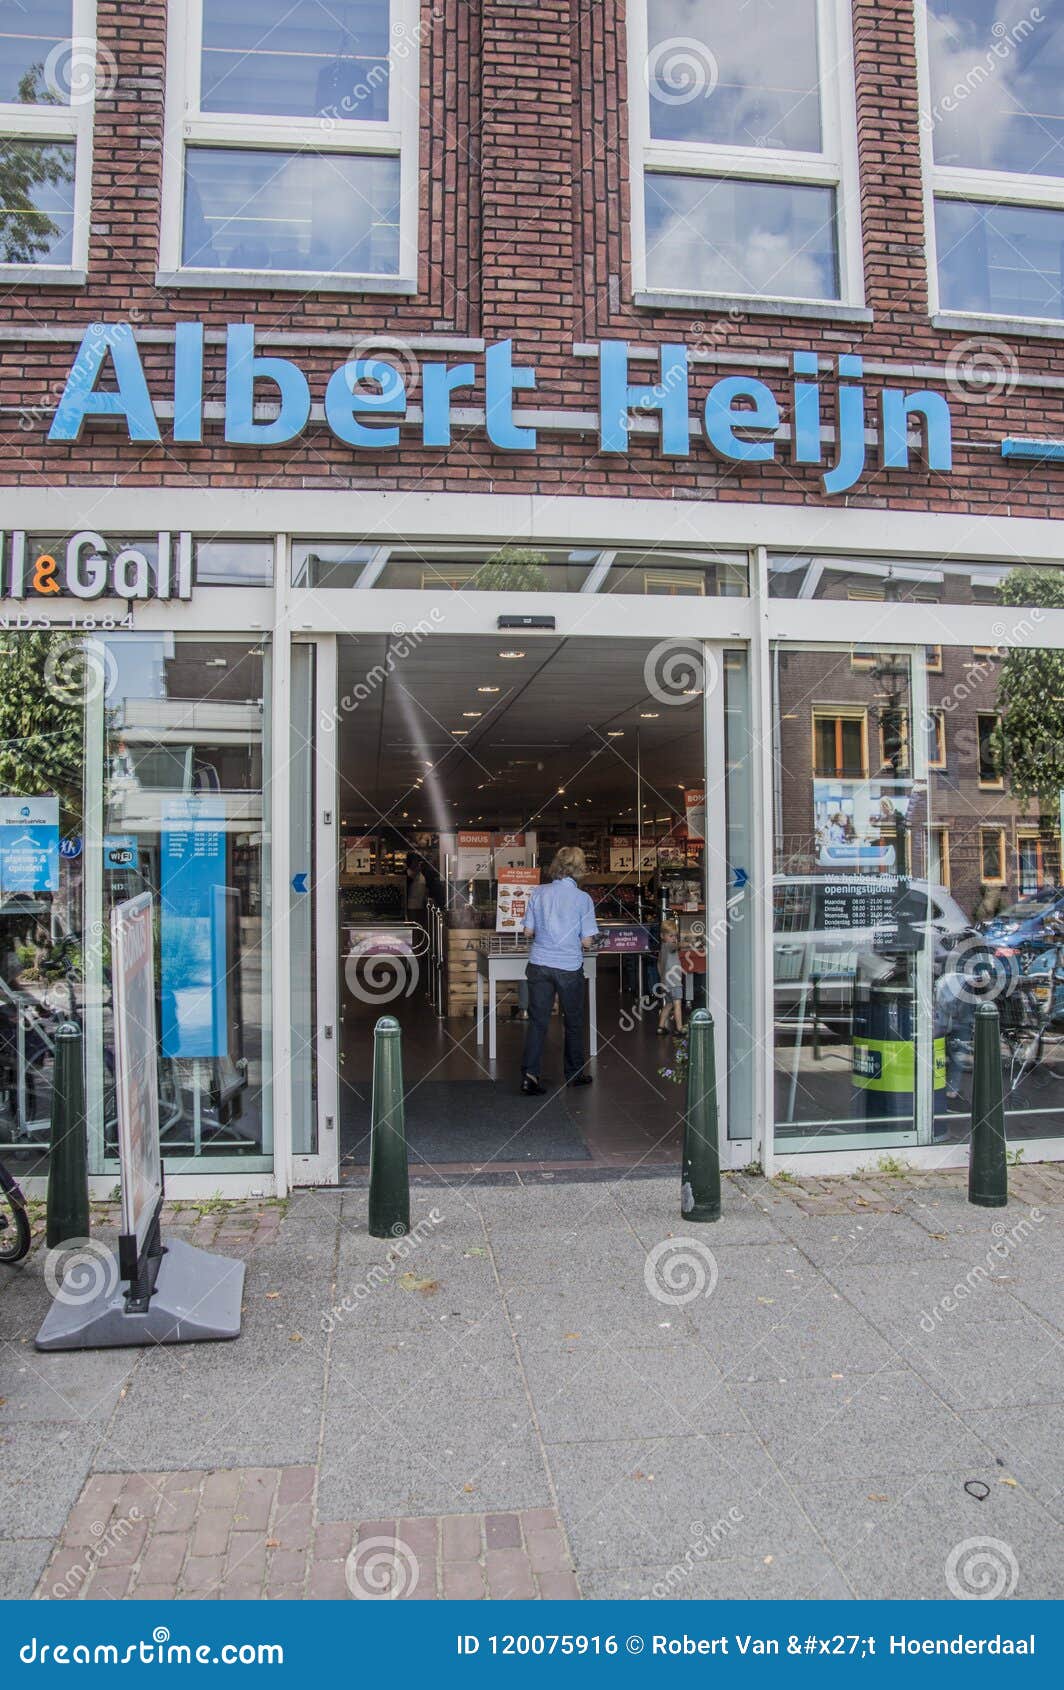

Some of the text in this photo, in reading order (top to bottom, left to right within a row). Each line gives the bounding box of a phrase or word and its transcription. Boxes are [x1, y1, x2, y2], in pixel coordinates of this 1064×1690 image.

[49, 323, 952, 494] Albert Heijn
[70, 612, 135, 629] 1884
[460, 835, 489, 843] BONUS
